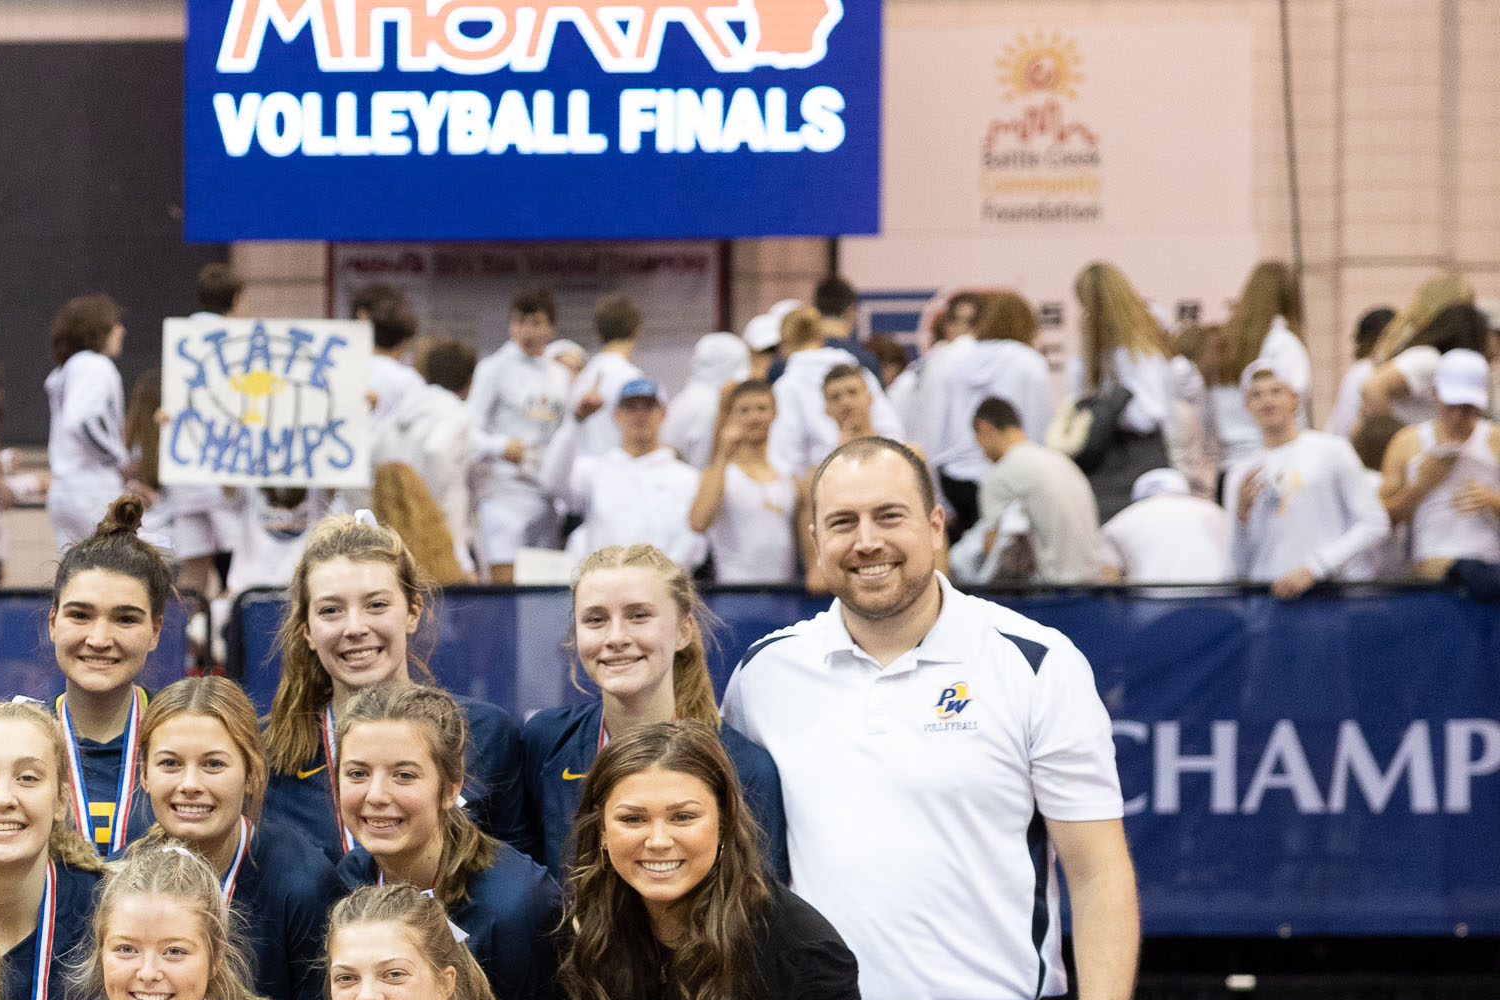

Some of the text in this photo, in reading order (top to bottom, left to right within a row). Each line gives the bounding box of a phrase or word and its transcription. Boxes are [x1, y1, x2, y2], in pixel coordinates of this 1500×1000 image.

[213, 86, 847, 156] VOLLEYBALL FINALS
[178, 322, 347, 389] STATE
[170, 407, 354, 478] CHAMPS
[934, 687, 972, 714] PW
